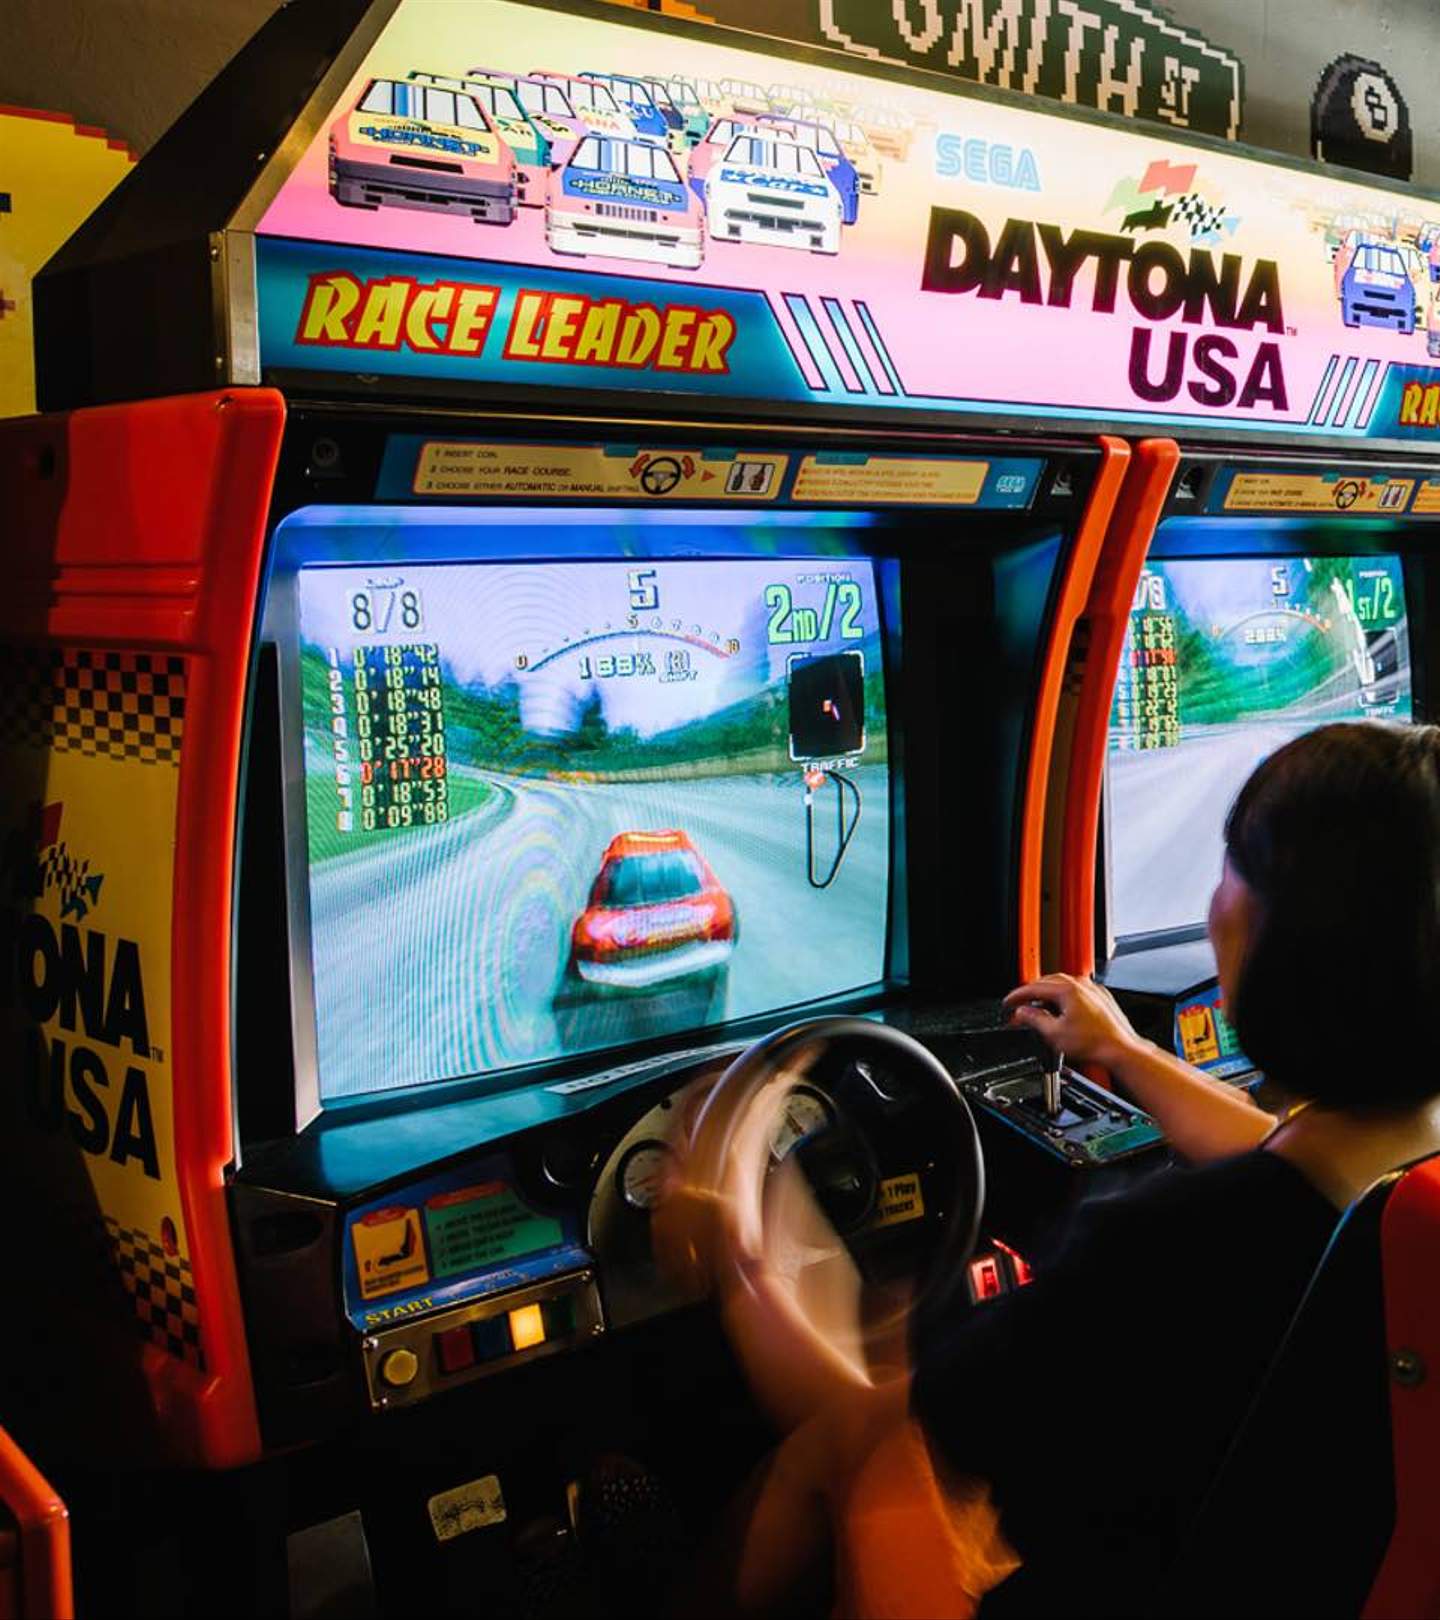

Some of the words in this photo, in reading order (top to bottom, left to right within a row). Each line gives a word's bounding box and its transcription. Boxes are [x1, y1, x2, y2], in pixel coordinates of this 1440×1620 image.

[1158, 57, 1200, 124] ST
[936, 133, 1042, 193] SEGA
[921, 205, 1285, 335] DAYTONA
[298, 273, 499, 358] RACE
[504, 289, 736, 373] LEADER
[1128, 327, 1289, 411] USA
[628, 569, 659, 610] 5
[364, 1297, 434, 1325] START
